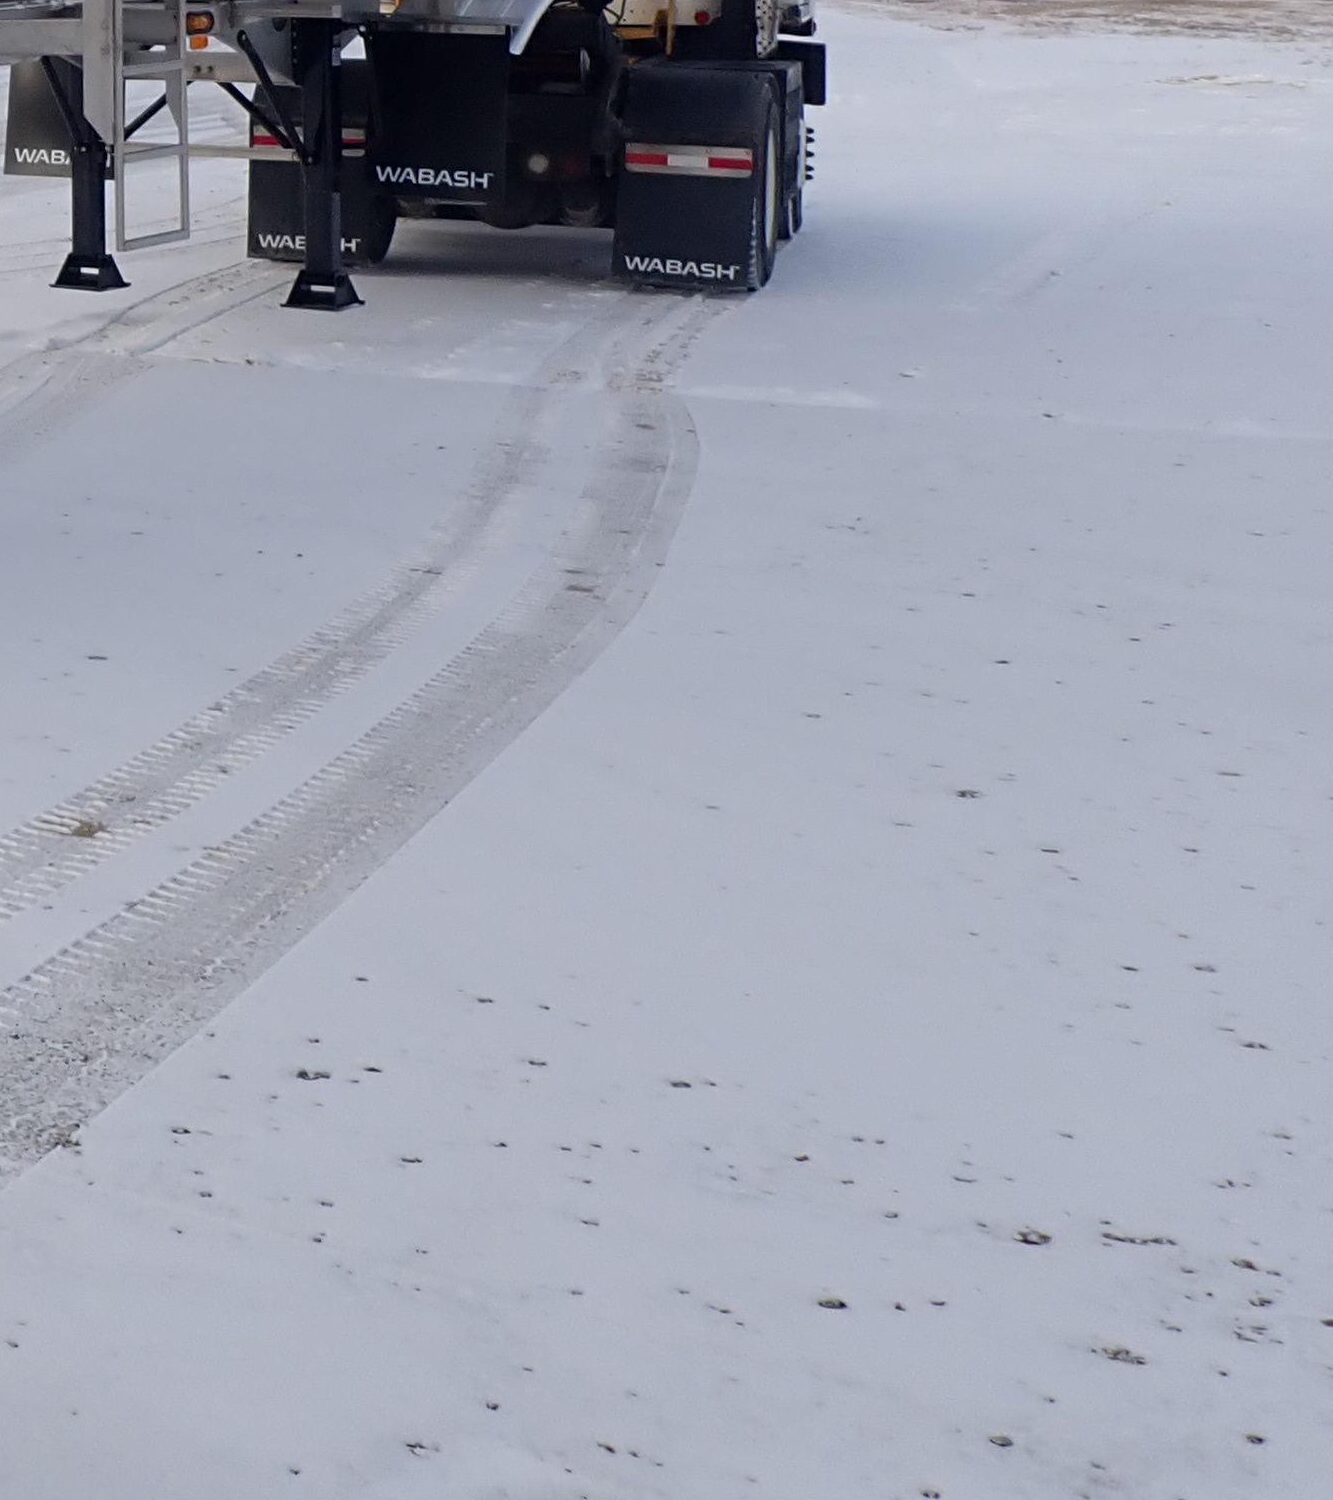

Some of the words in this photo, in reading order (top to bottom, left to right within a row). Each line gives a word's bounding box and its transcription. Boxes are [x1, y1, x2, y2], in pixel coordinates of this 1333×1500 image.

[376, 165, 489, 189] WABASH
[258, 233, 357, 252] WABH
[624, 255, 735, 280] WABASH
